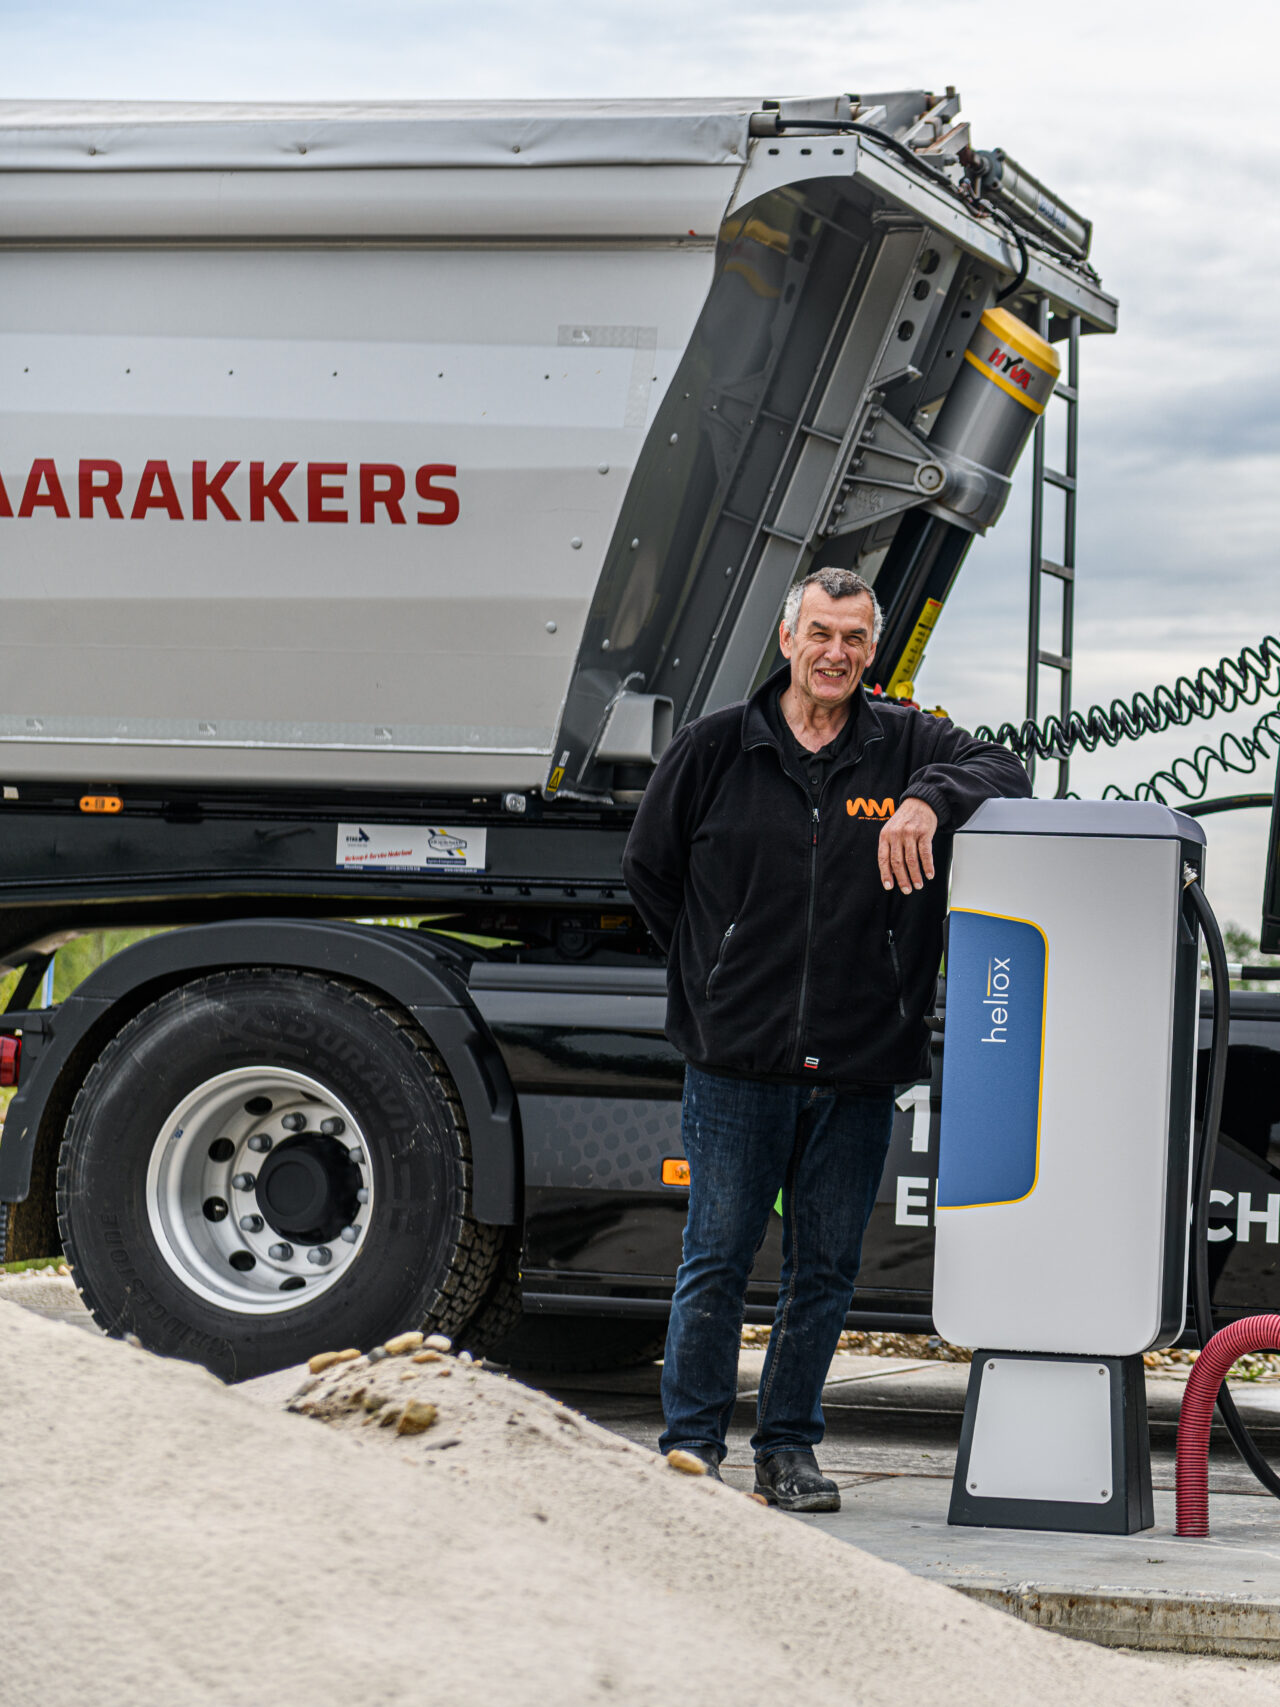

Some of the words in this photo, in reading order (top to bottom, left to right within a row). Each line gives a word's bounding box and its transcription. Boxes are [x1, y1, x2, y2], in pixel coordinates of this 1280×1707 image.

[988, 347, 1032, 390] HYVA
[0, 458, 461, 526] ARAKKERS
[981, 957, 1011, 1044] heliox
